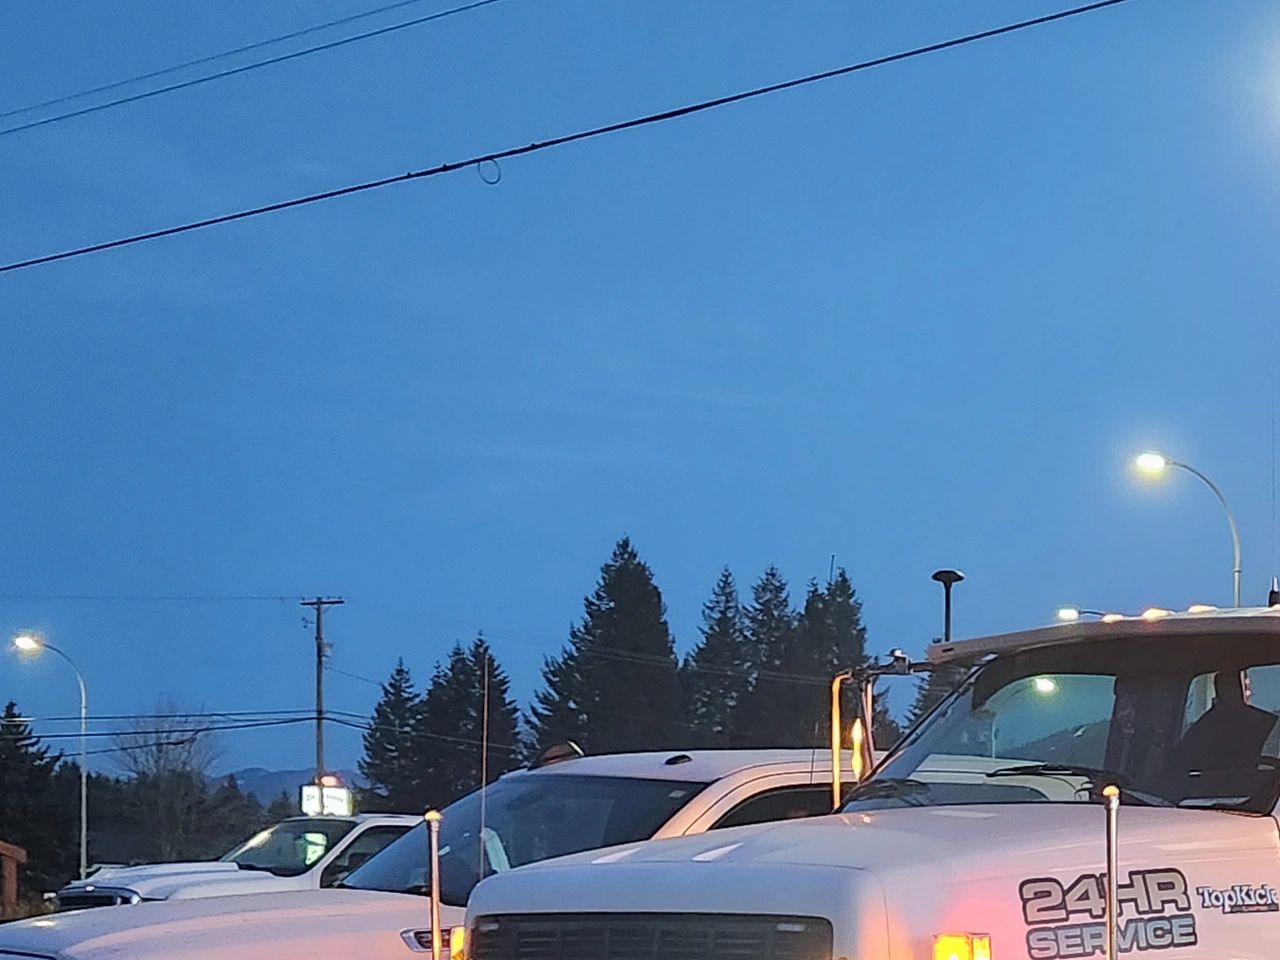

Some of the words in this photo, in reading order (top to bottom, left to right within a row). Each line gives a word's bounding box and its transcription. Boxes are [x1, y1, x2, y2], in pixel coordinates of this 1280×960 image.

[1019, 868, 1191, 925] 24HR
[1196, 884, 1279, 914] TopKick
[1026, 914, 1197, 960] SERVICE
